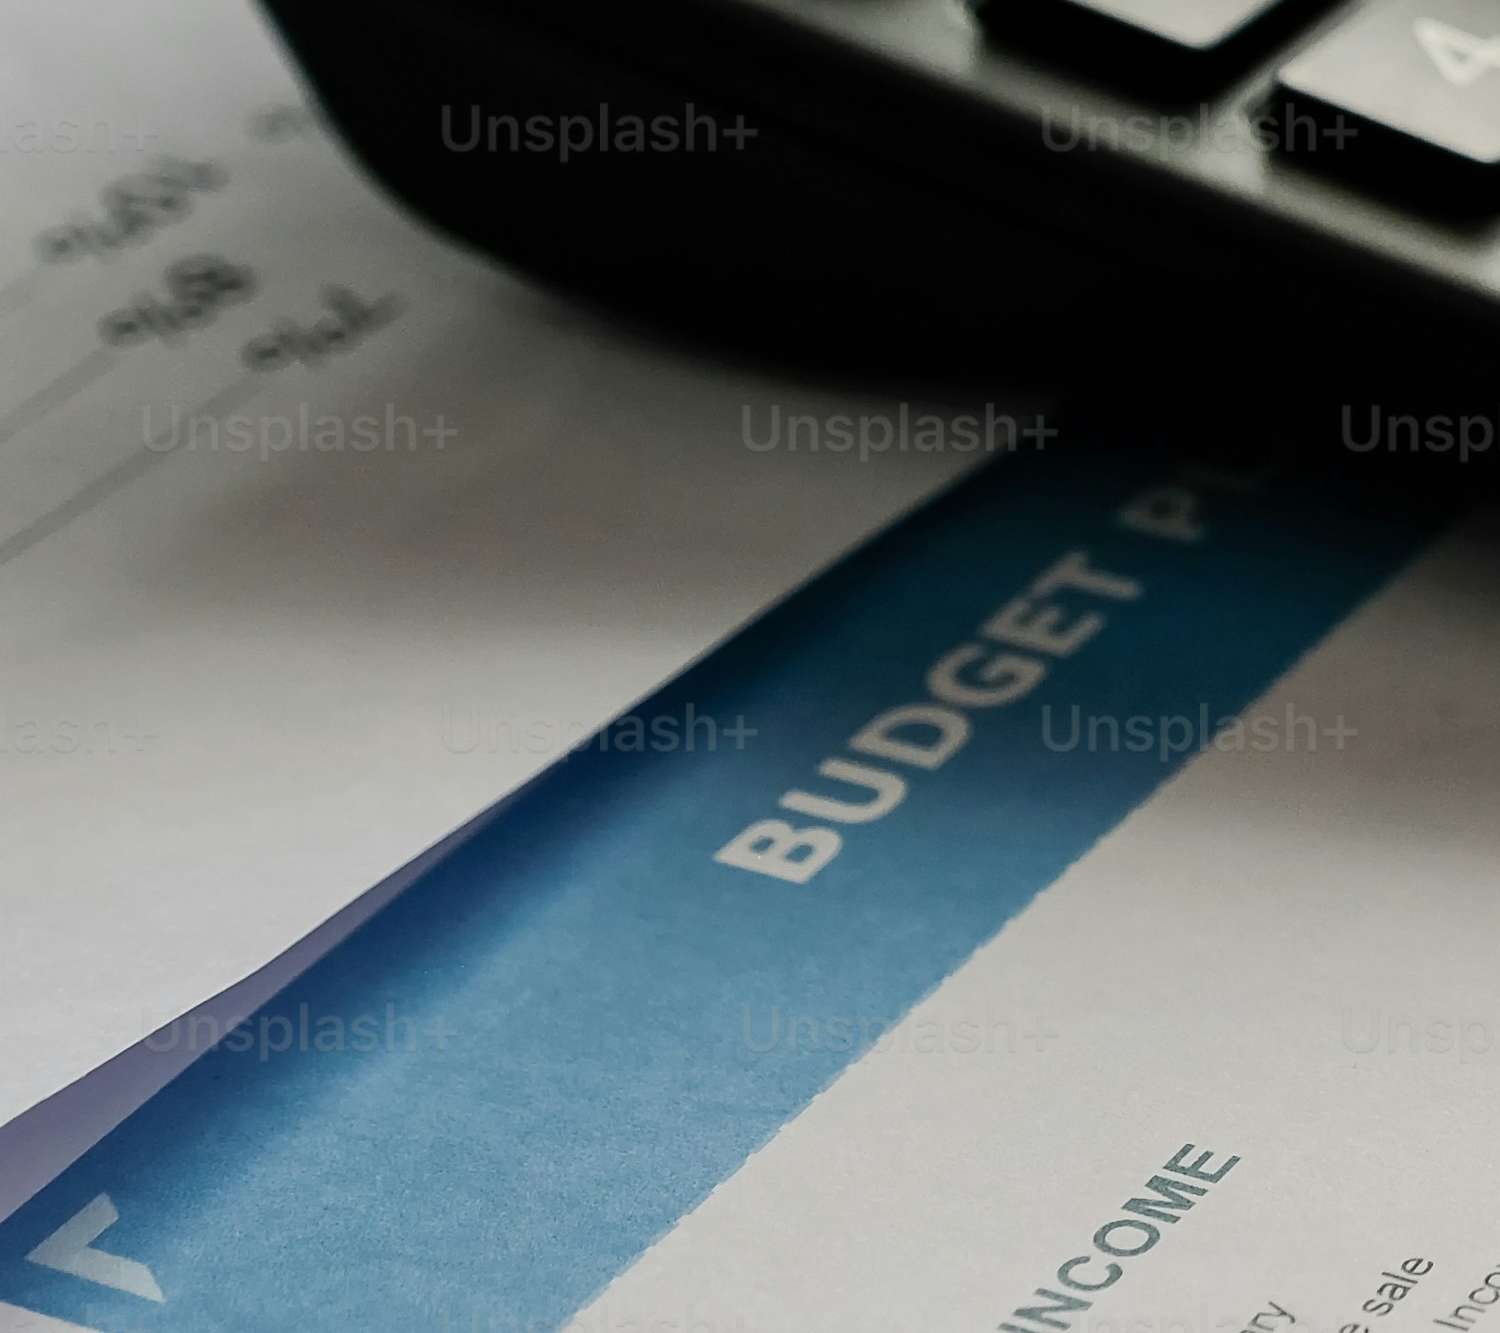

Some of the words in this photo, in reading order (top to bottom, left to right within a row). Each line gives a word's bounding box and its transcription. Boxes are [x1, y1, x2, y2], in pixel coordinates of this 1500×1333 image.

[711, 546, 1147, 885] BUDGET
[997, 1143, 1241, 1333] INCOME
[1362, 1257, 1434, 1317] sale
